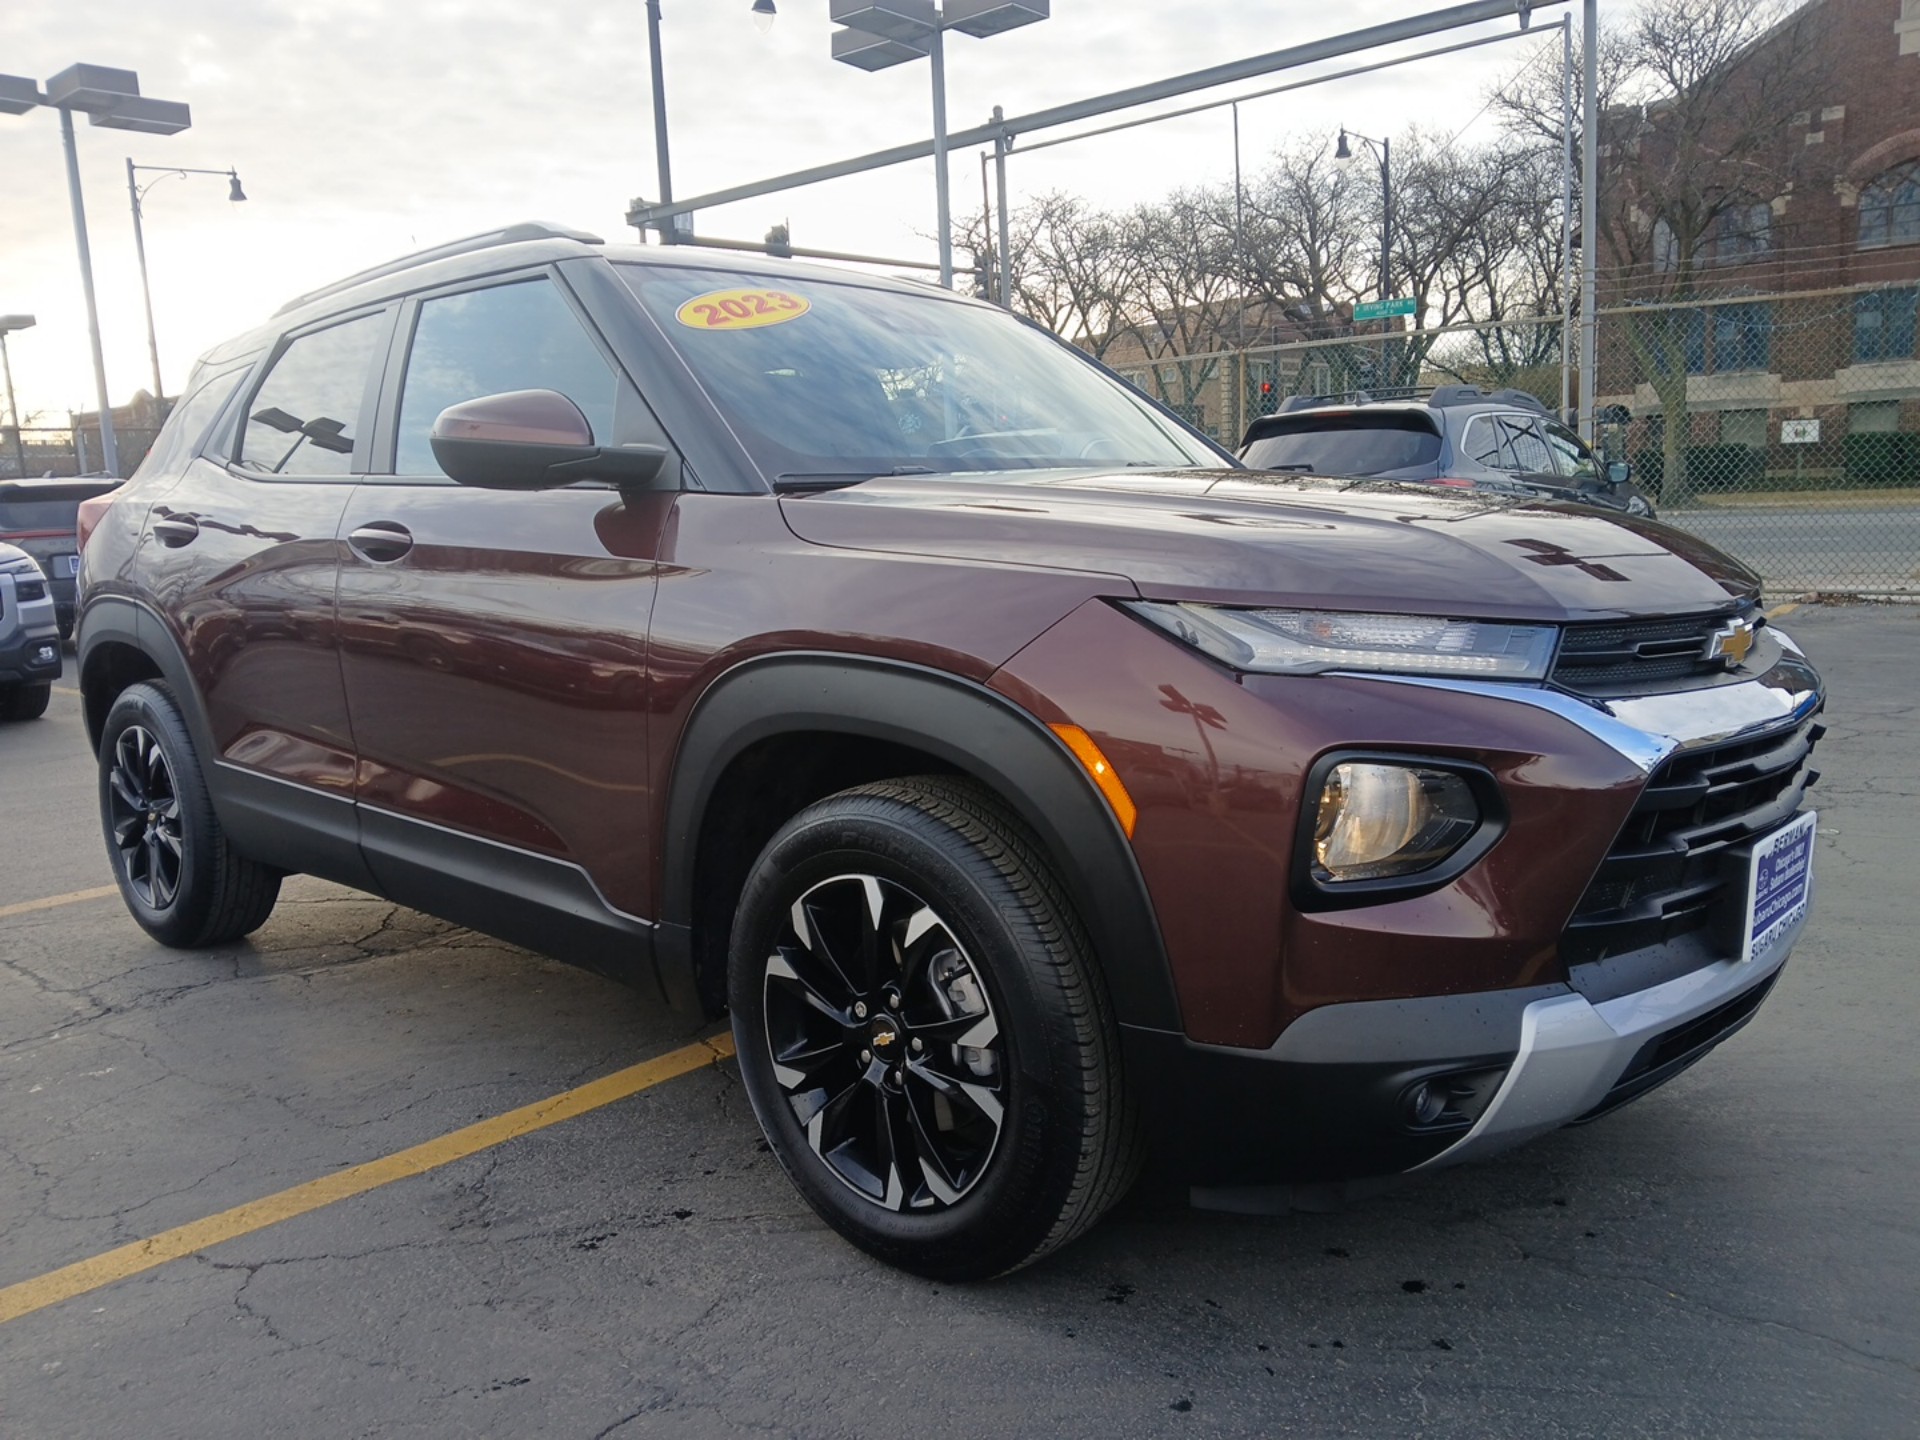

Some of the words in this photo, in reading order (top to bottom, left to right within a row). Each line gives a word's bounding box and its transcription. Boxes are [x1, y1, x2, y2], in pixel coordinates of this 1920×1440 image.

[692, 291, 802, 326] 2023
[1363, 303, 1383, 312] IRVING
[1386, 300, 1404, 309] PARK
[1769, 869, 1786, 892] Subaru
